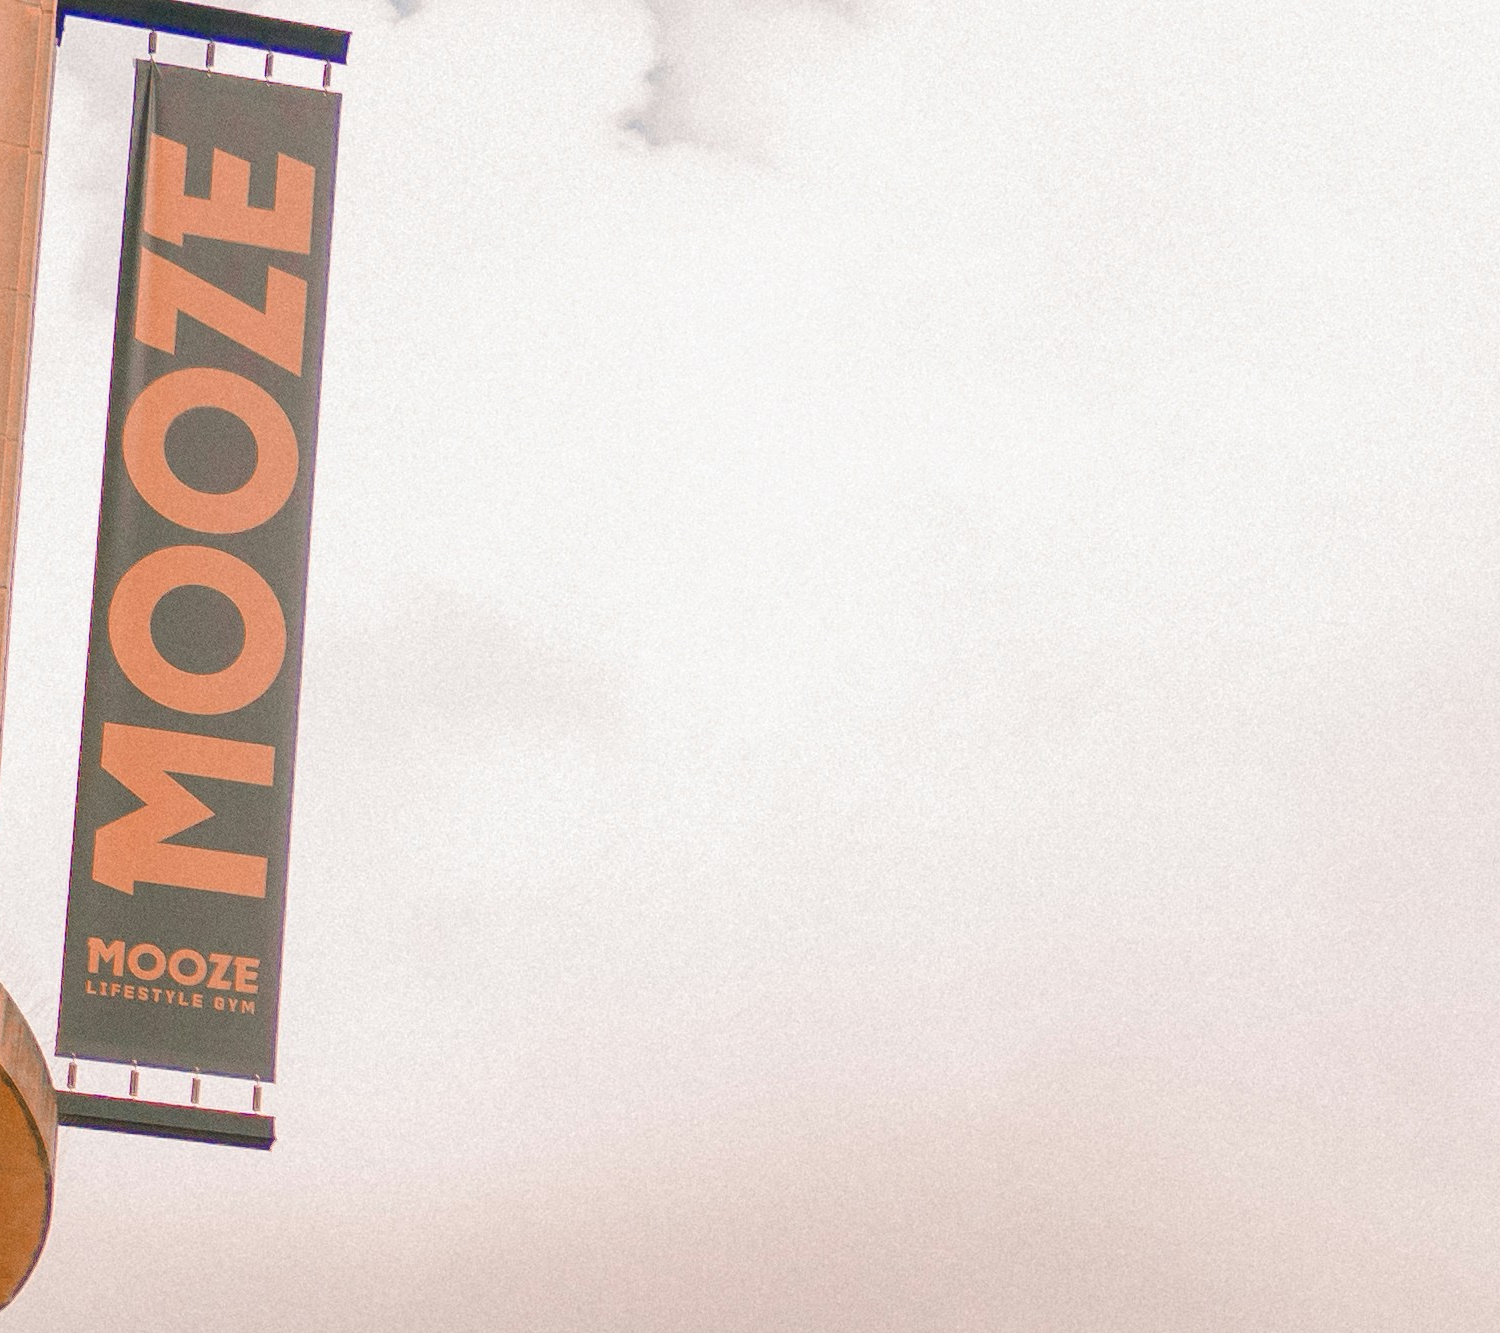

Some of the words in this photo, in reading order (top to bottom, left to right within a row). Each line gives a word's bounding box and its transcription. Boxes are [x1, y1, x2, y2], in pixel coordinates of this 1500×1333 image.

[91, 133, 316, 899] MOOZE
[86, 936, 261, 995] MOOZE
[84, 979, 204, 1009] LIFESTYLE
[212, 996, 257, 1016] GYM
